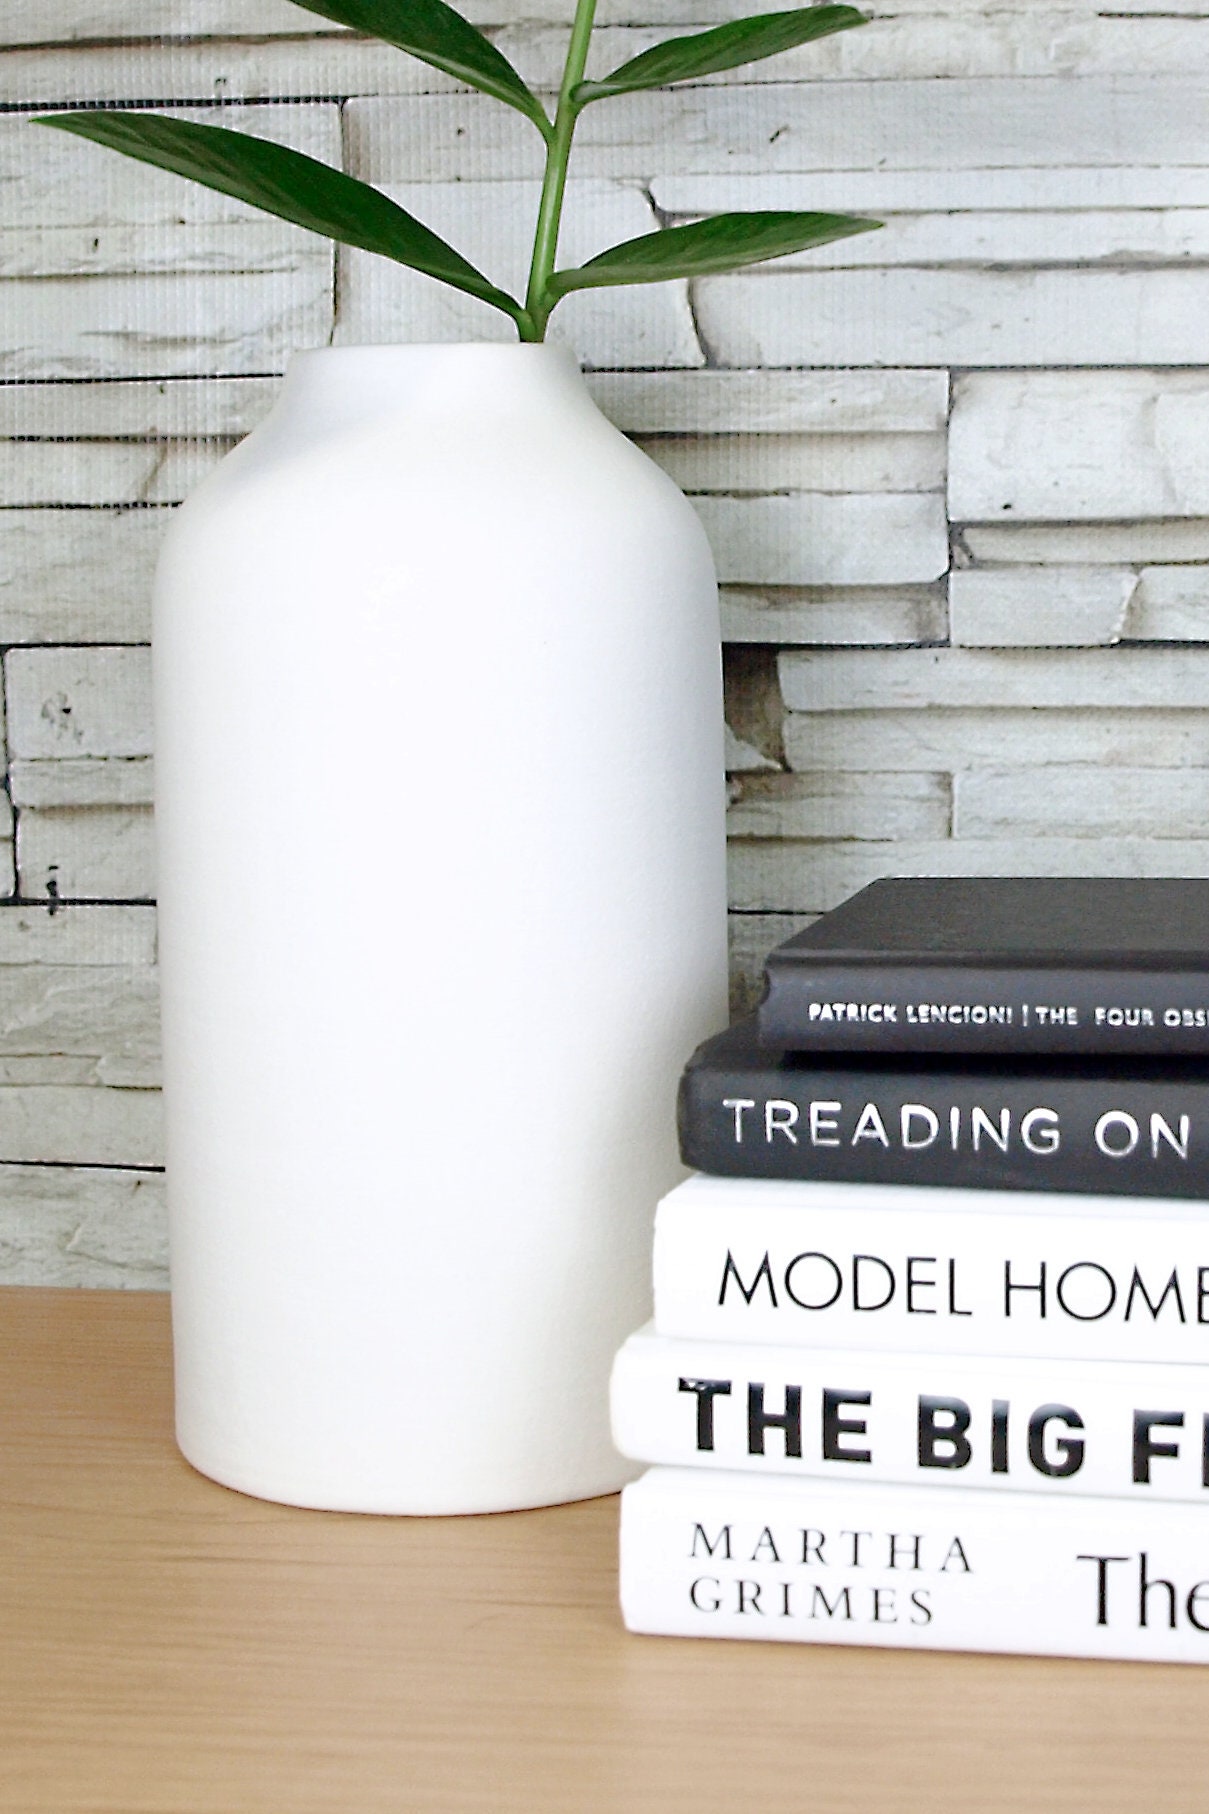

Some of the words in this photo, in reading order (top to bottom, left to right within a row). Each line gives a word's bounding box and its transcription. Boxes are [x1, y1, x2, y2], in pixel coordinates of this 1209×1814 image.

[808, 1002, 898, 1023] PATRICK
[906, 1003, 1013, 1025] LENCIONI
[1034, 1005, 1078, 1026] THE
[1094, 1006, 1155, 1027] FOUR
[722, 1098, 1061, 1155] TREADING
[1094, 1110, 1191, 1159] ON
[717, 1250, 973, 1317] MODEL
[677, 1376, 873, 1465] THE
[916, 1395, 1086, 1480] BIG
[690, 1522, 972, 1573] MARTHA
[689, 1579, 933, 1624] GRIMES
